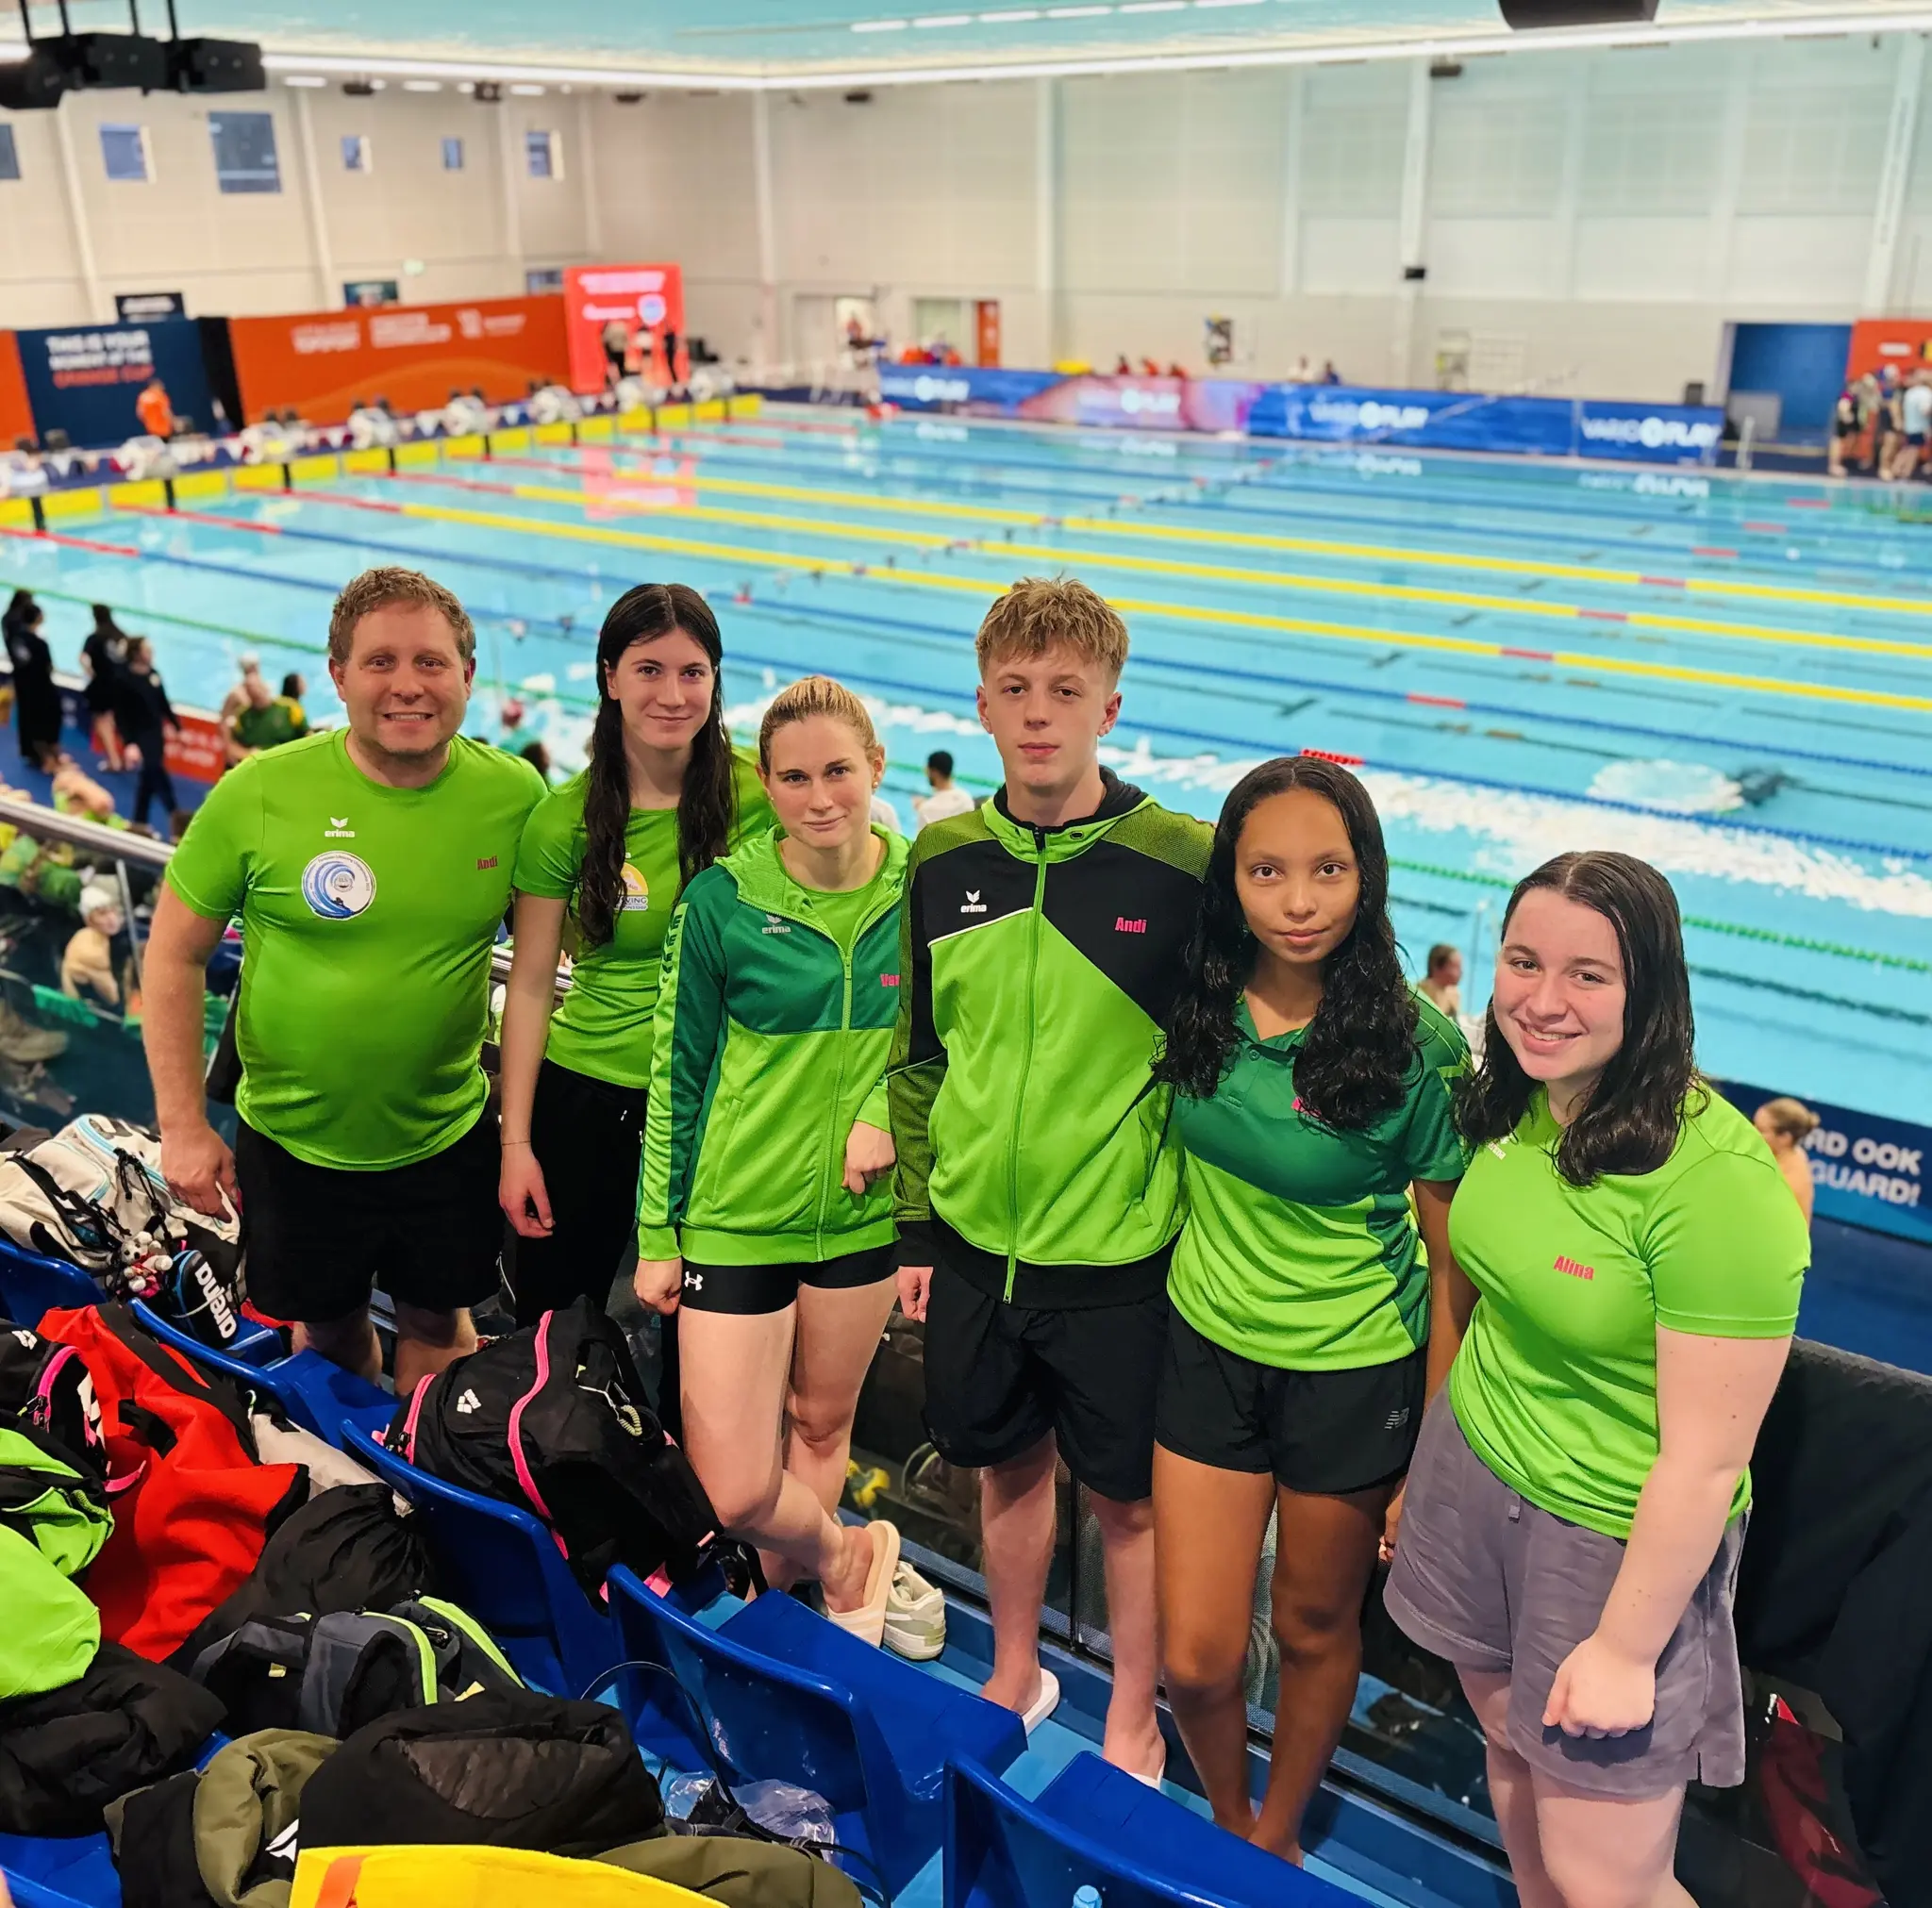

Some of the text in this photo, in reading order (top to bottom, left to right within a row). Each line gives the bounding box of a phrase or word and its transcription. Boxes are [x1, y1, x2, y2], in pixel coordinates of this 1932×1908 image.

[325, 829, 356, 838] erima
[477, 855, 497, 871] Andi
[960, 904, 987, 913] erima
[762, 924, 791, 935] erima
[1114, 917, 1148, 934] Andi
[1798, 1128, 1924, 1176] RD OOK
[1553, 1255, 1594, 1281] Alina
[194, 1261, 237, 1338] arena
